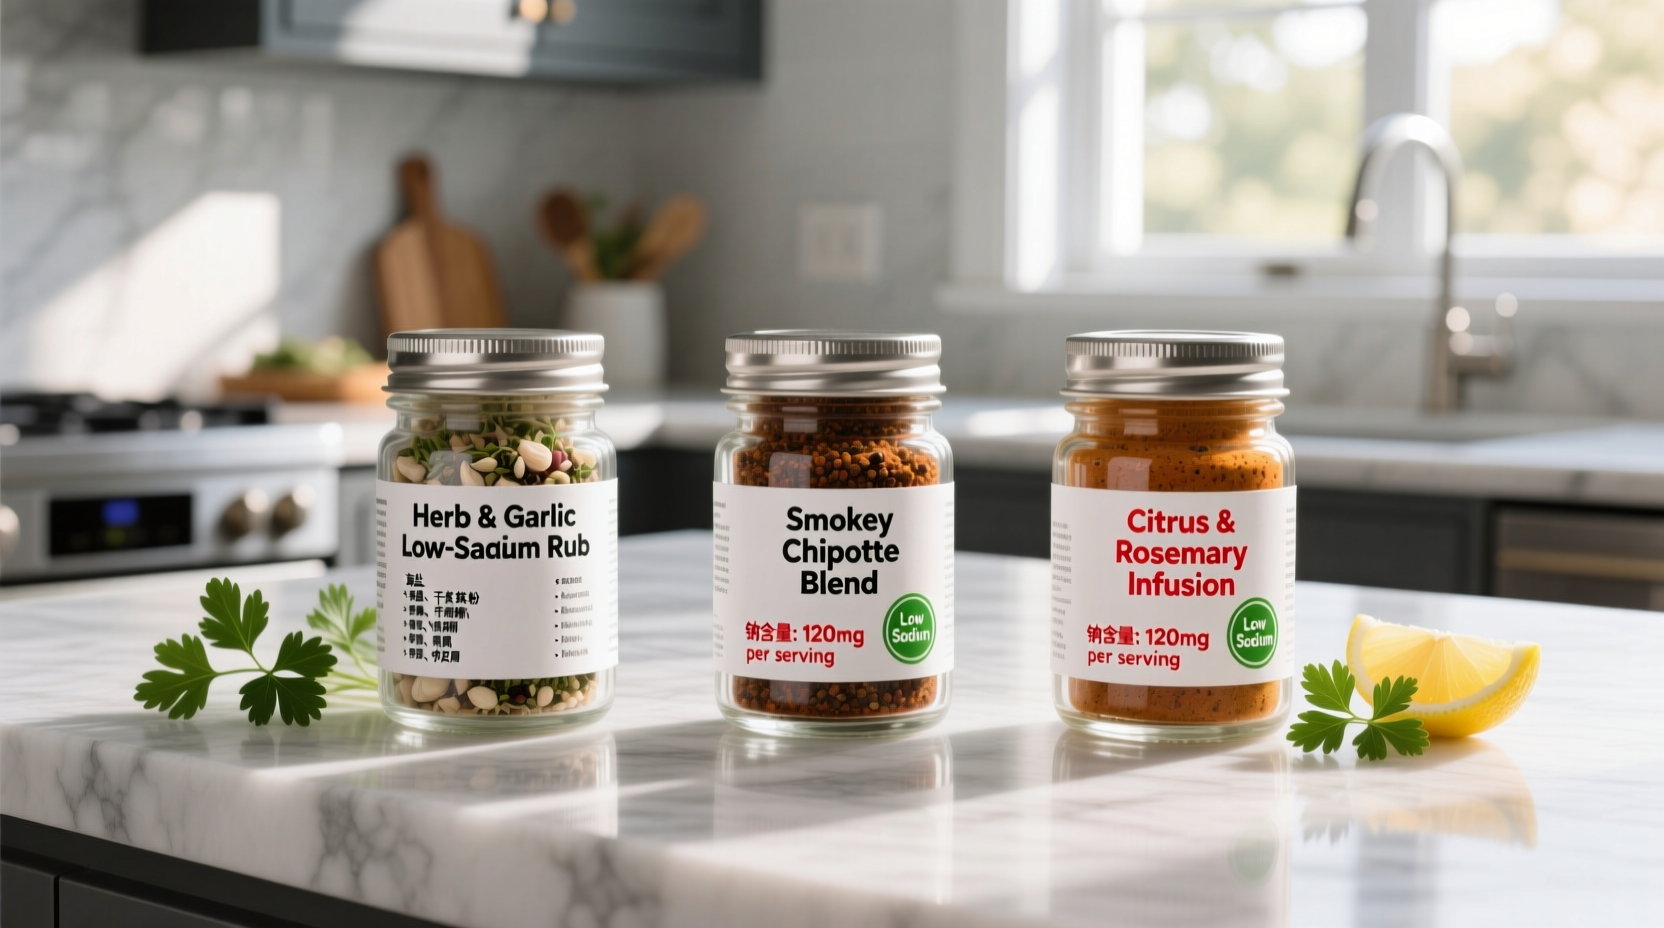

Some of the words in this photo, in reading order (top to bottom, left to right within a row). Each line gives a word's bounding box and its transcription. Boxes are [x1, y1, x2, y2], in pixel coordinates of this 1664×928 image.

[413, 502, 471, 528] Herb
[478, 504, 497, 529] &
[504, 502, 576, 529] Garlic
[786, 506, 894, 538] Smokey
[1127, 508, 1210, 534] Citrus
[1216, 508, 1236, 534] &
[547, 533, 590, 558] Rub
[782, 537, 900, 571] Chipotte
[1116, 539, 1248, 571] Rosemary
[801, 569, 878, 595] Blend
[1128, 570, 1236, 597] Infusion
[900, 611, 925, 626] Low
[1243, 616, 1267, 632] Low
[802, 623, 865, 649] 120mg
[1145, 627, 1210, 652] 120mg
[746, 647, 770, 665] per
[775, 647, 835, 669] serving
[1087, 650, 1113, 667] per
[1117, 650, 1181, 671] serving
